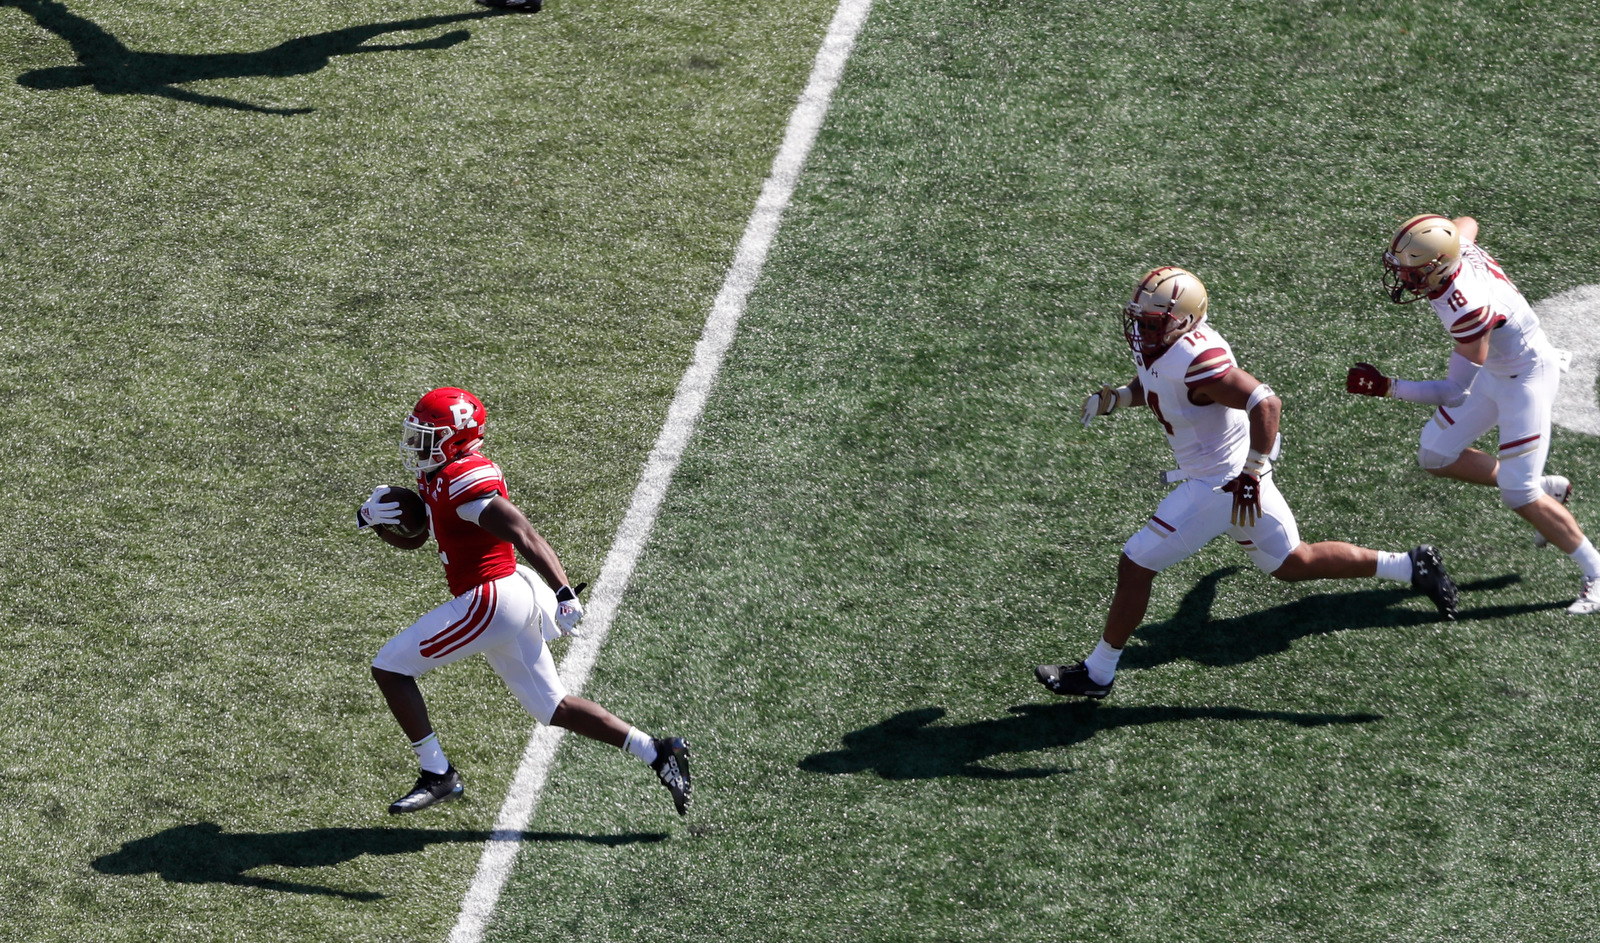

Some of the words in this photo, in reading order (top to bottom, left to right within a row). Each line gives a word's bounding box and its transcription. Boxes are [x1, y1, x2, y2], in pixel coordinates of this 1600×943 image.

[1447, 290, 1468, 312] 18
[1183, 331, 1207, 346] 14
[450, 401, 477, 430] R
